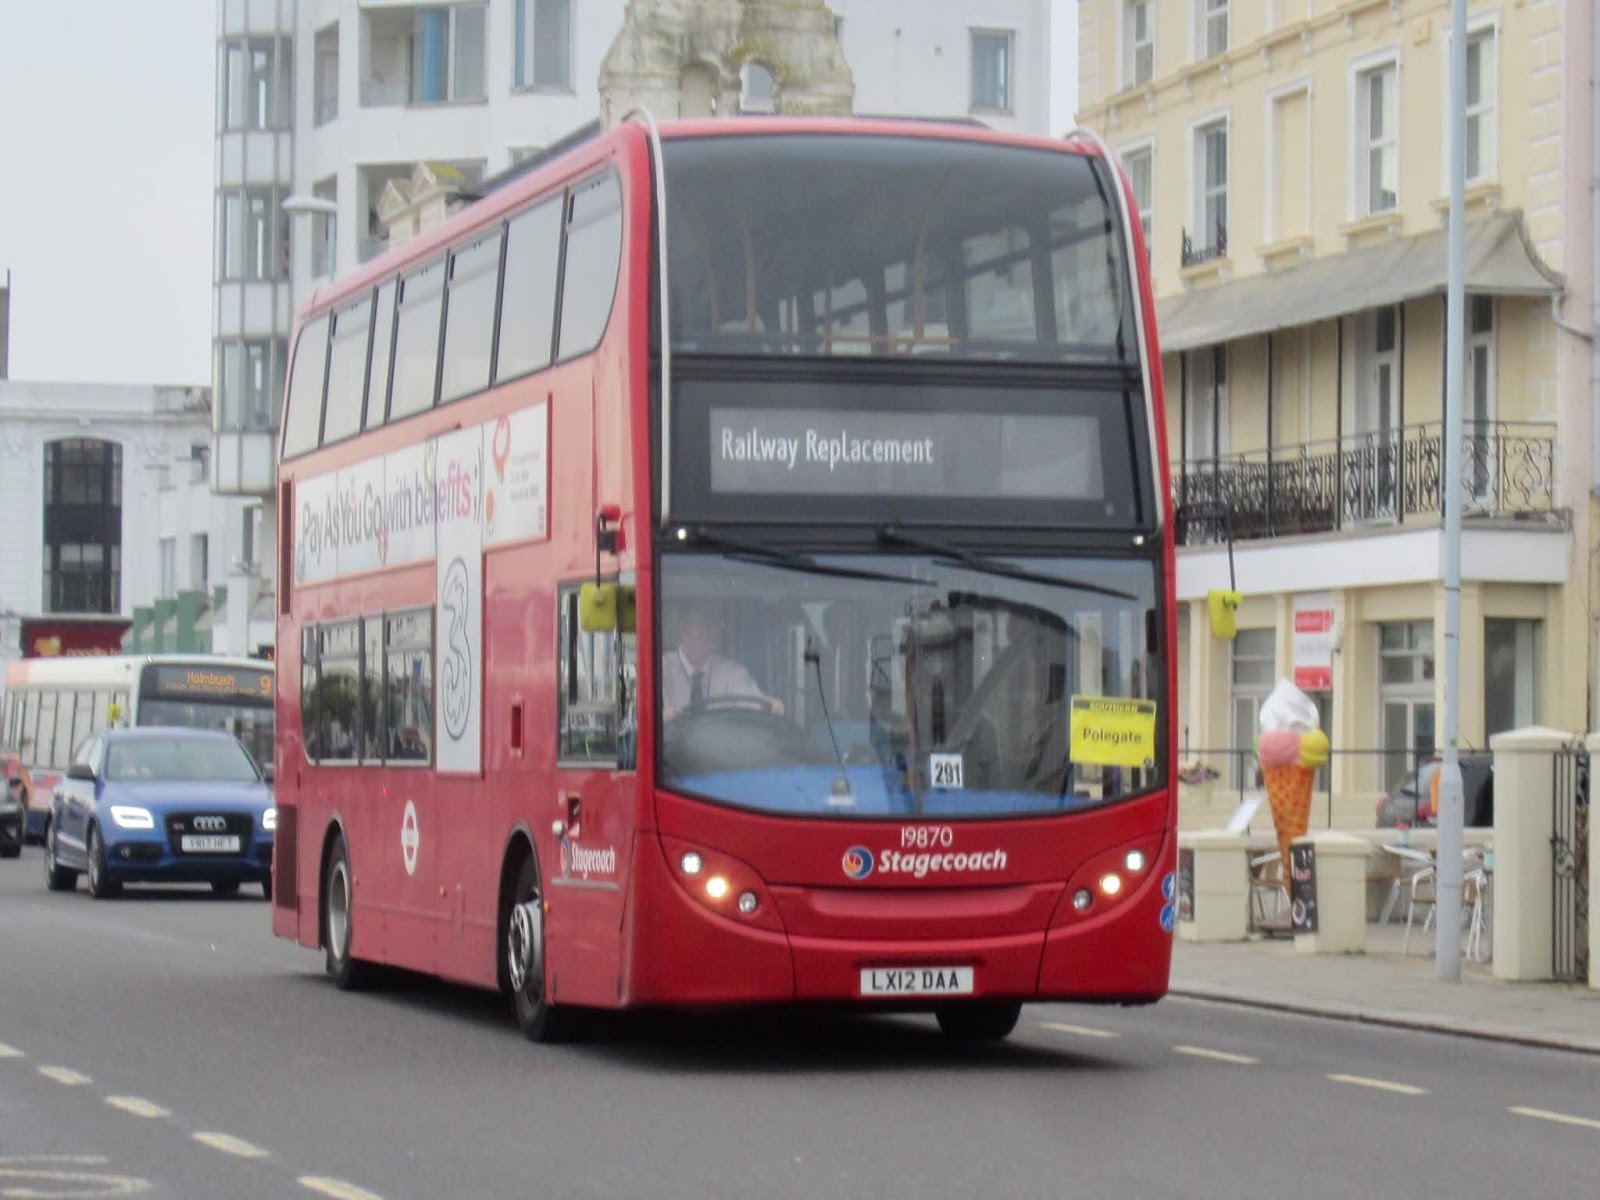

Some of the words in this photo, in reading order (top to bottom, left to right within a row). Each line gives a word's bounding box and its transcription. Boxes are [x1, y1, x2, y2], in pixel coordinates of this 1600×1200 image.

[721, 427, 799, 470] Railway
[805, 428, 934, 471] Replacement
[302, 501, 324, 565] Pay
[324, 495, 340, 550] As
[340, 488, 362, 545] You
[362, 480, 384, 542] Go
[383, 472, 412, 532] with
[414, 458, 471, 526] benefits
[187, 671, 235, 687] Holmbush
[1082, 727, 1142, 745] Polegate
[935, 762, 961, 784] 291
[901, 826, 953, 848] 19870
[571, 842, 616, 880] Stagecoach
[878, 848, 1008, 878] Stagecoach
[871, 969, 916, 991] LX12
[922, 968, 959, 991] DAA
